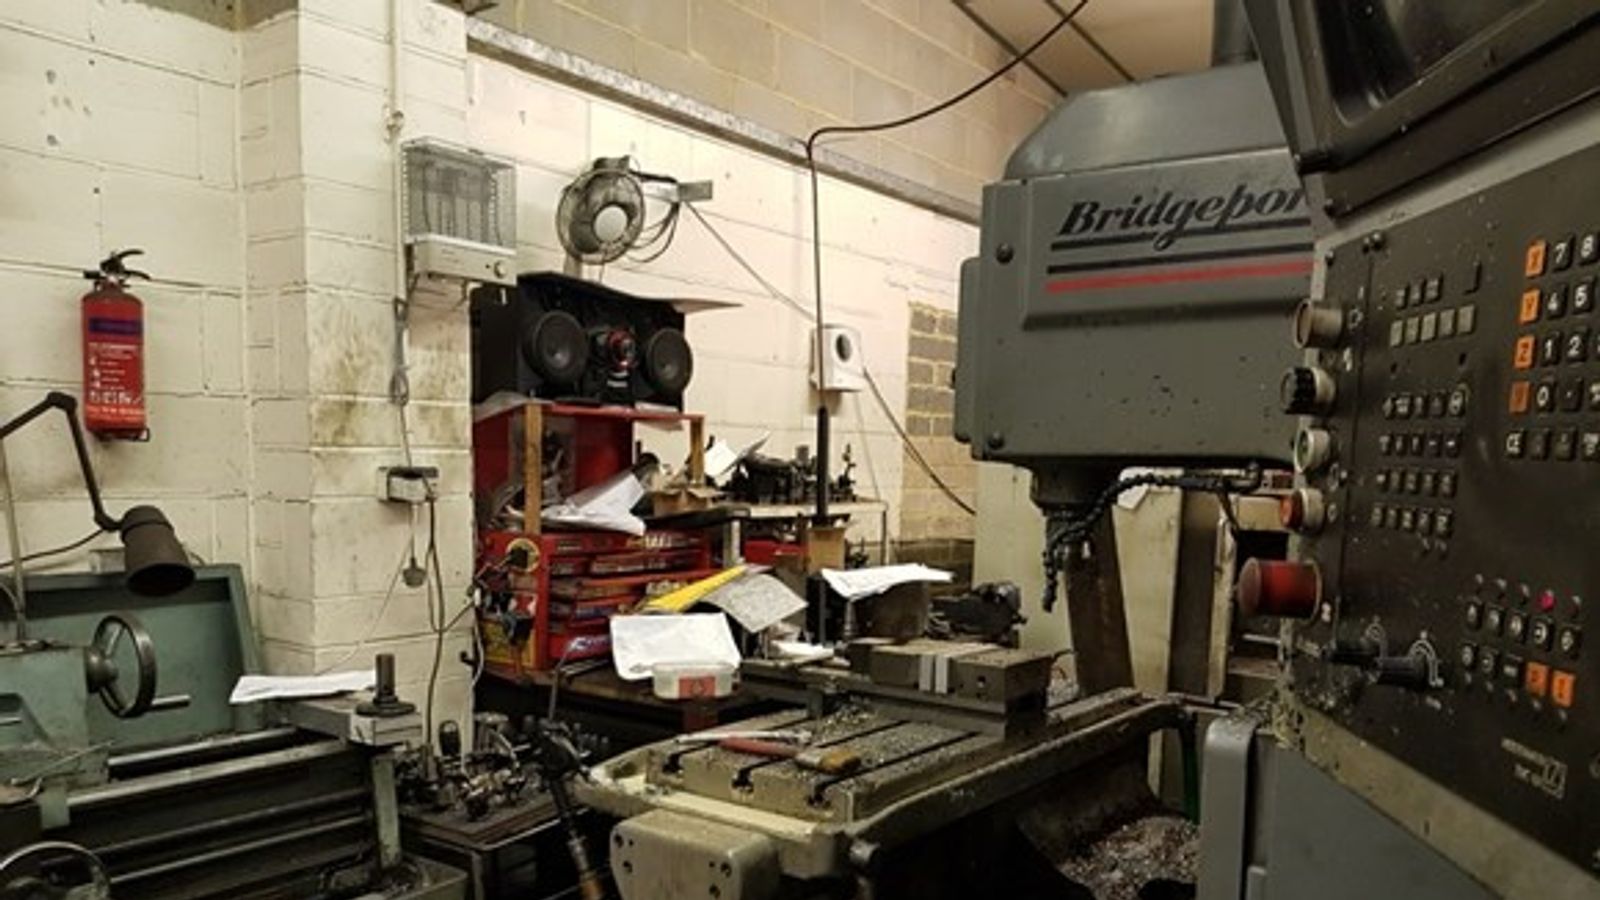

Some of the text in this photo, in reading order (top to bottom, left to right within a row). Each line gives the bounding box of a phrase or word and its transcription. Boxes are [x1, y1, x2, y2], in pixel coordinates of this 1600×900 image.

[1059, 184, 1307, 250] Bridgepor
[1555, 242, 1567, 264] 7
[1580, 235, 1595, 259] 8
[1574, 284, 1588, 307] 5
[1544, 339, 1553, 360] 1
[1567, 335, 1582, 358] 2
